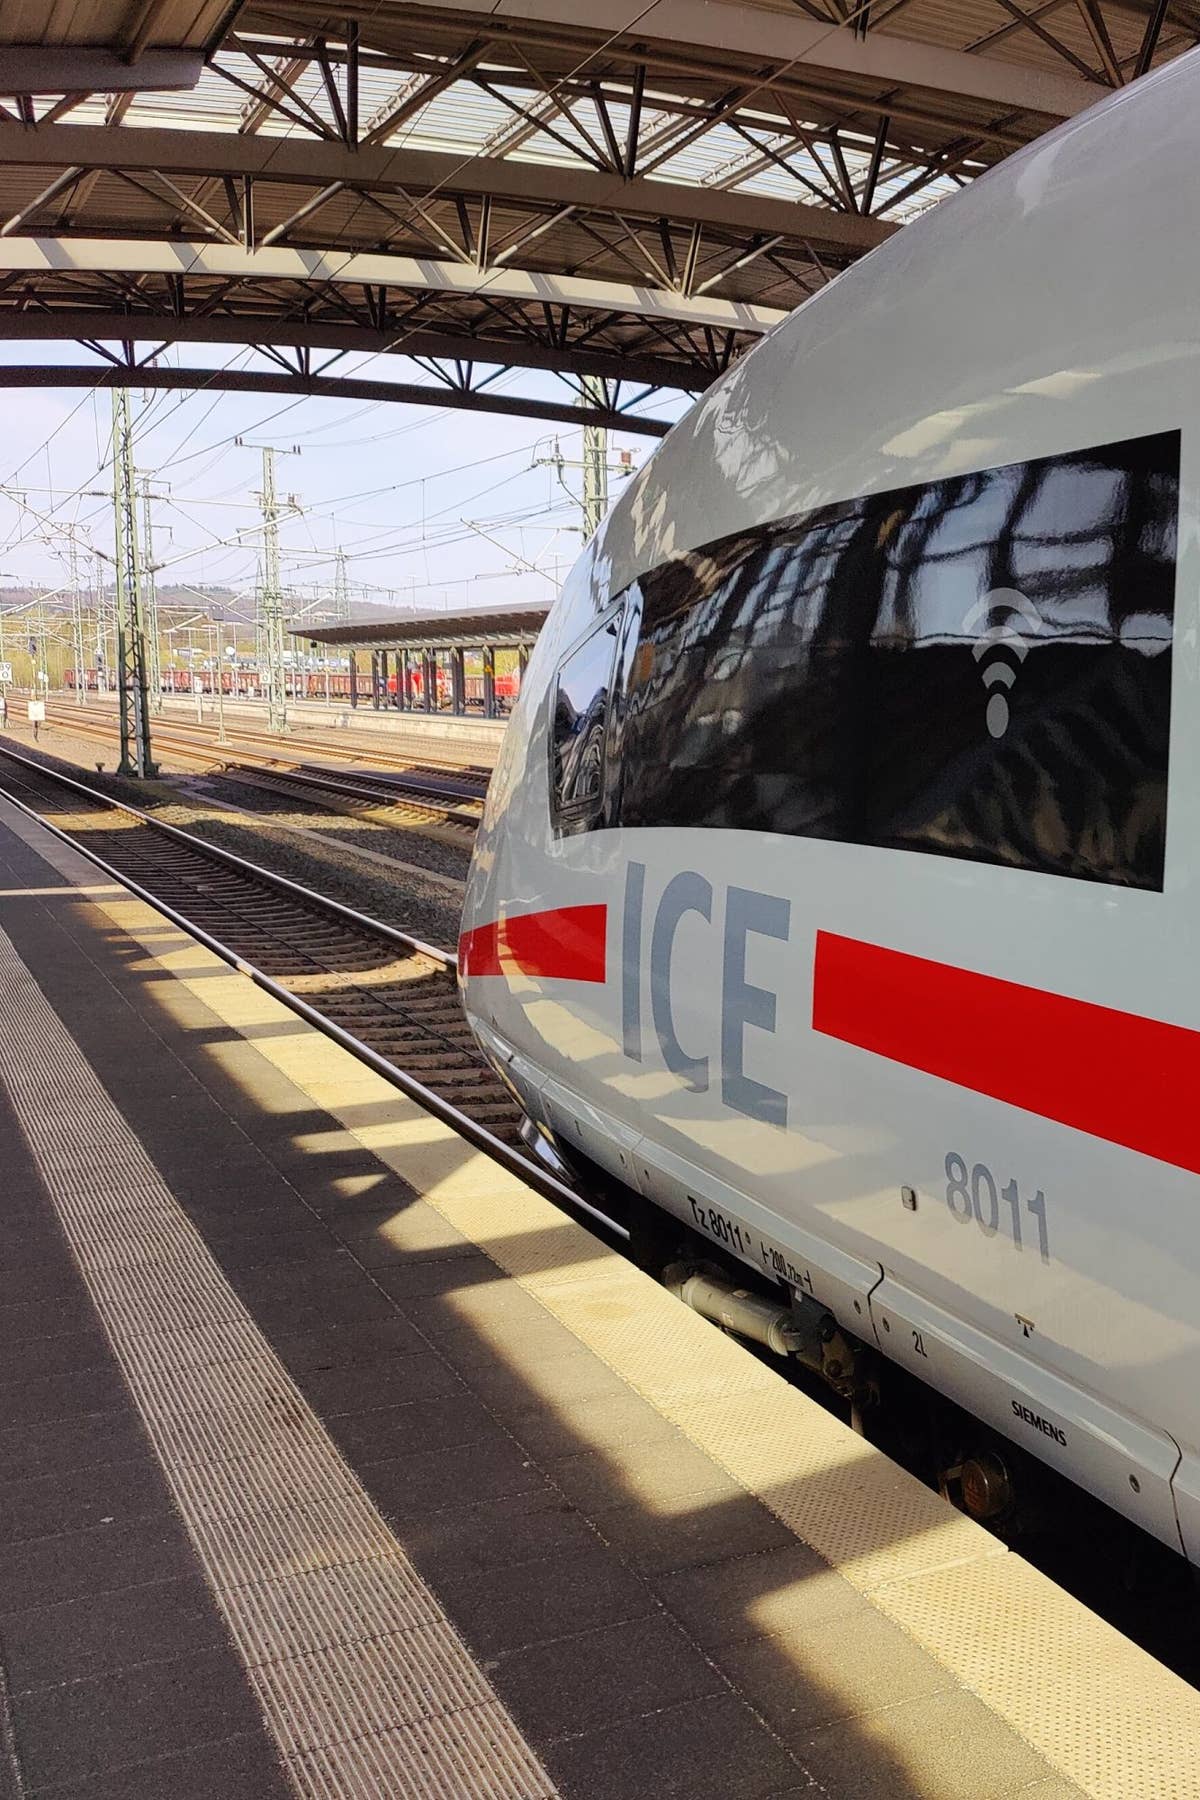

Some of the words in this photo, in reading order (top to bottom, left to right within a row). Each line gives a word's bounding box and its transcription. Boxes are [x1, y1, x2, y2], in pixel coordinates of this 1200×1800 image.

[622, 861, 791, 1134] ICE
[687, 1195, 709, 1231] Tz
[708, 1208, 745, 1254] 8011
[945, 1151, 1050, 1266] 8011
[912, 1331, 928, 1358] 2L
[1011, 1400, 1067, 1446] SIEMENS
